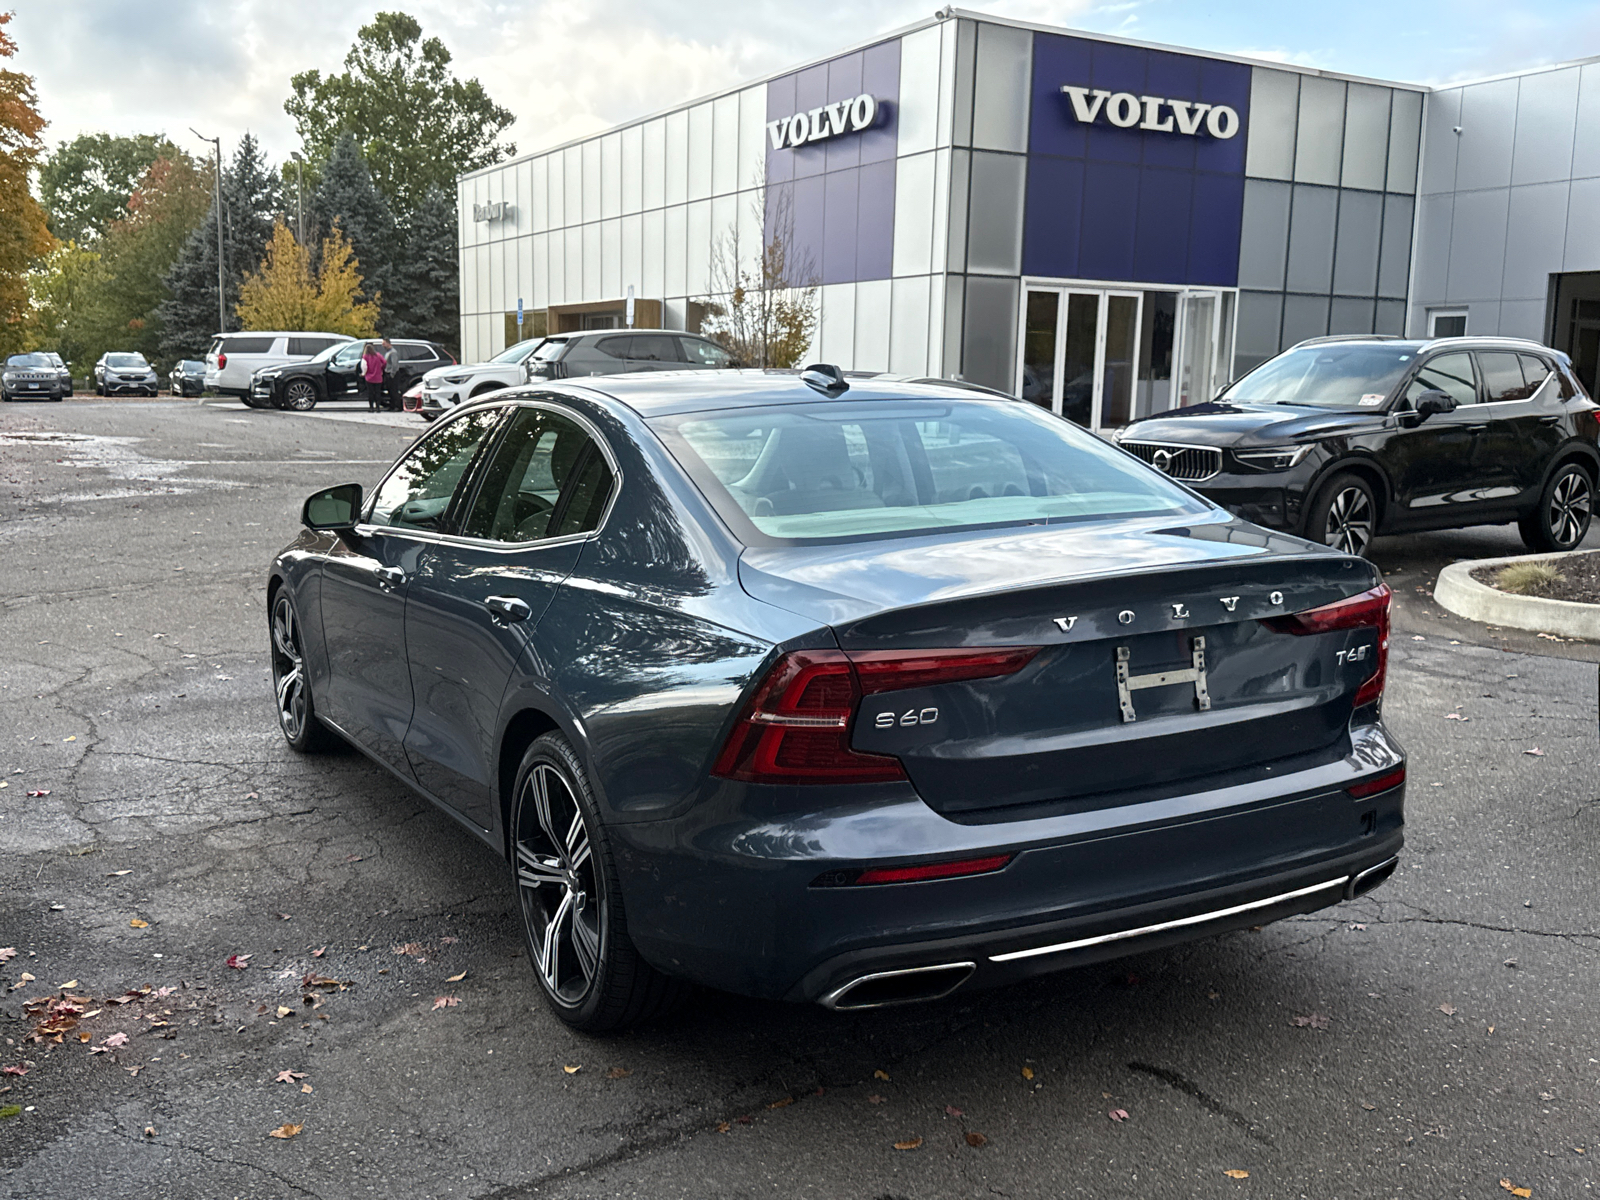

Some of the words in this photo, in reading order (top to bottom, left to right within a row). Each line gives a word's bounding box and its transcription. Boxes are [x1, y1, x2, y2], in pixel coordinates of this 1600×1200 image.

[766, 93, 876, 150] VOLVO
[1061, 85, 1240, 139] VOLVO
[1053, 591, 1284, 633] VOLVO
[874, 707, 939, 728] S60
